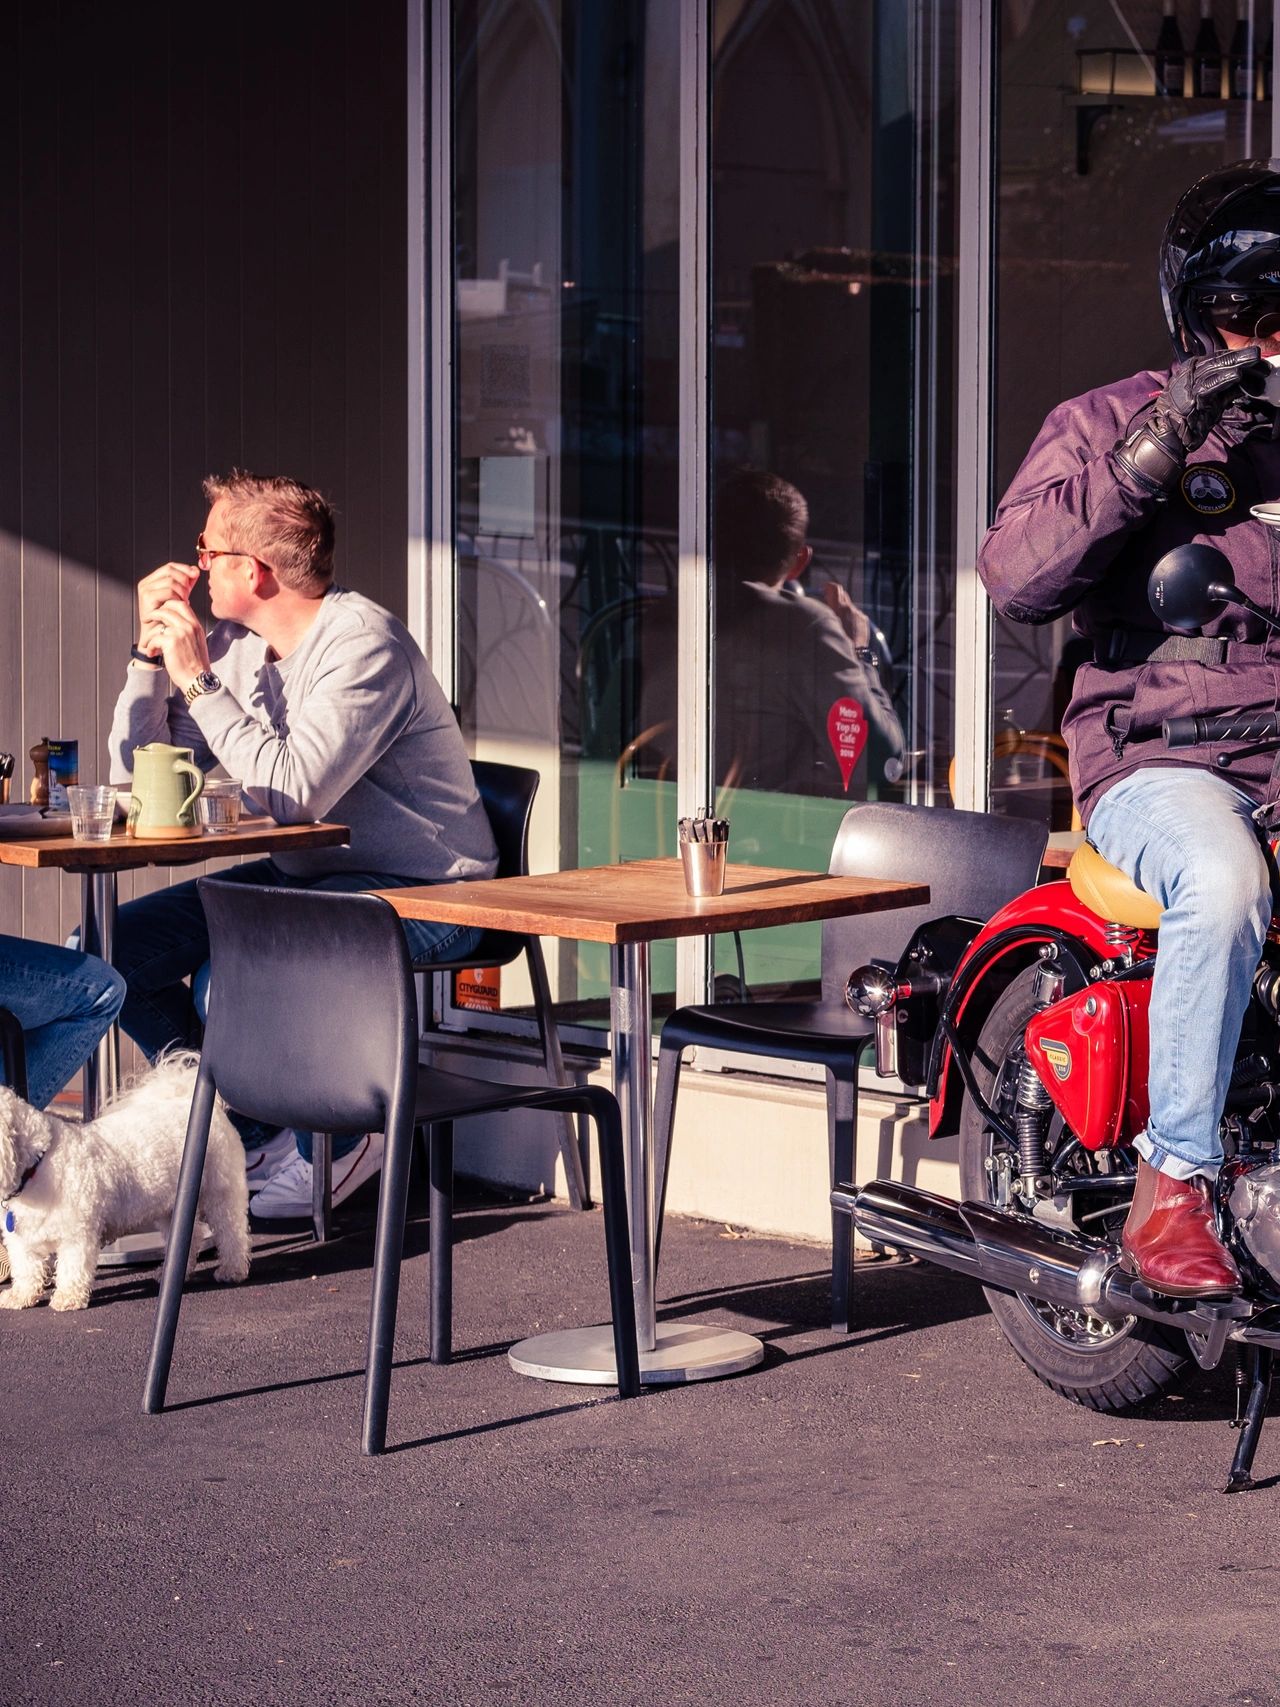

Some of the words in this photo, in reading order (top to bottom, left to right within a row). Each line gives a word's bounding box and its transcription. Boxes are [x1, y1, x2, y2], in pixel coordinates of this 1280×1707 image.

[839, 706, 858, 718] Metro
[835, 722, 850, 734] Top
[850, 723, 861, 734] 50
[459, 983, 498, 997] CITYGUARD
